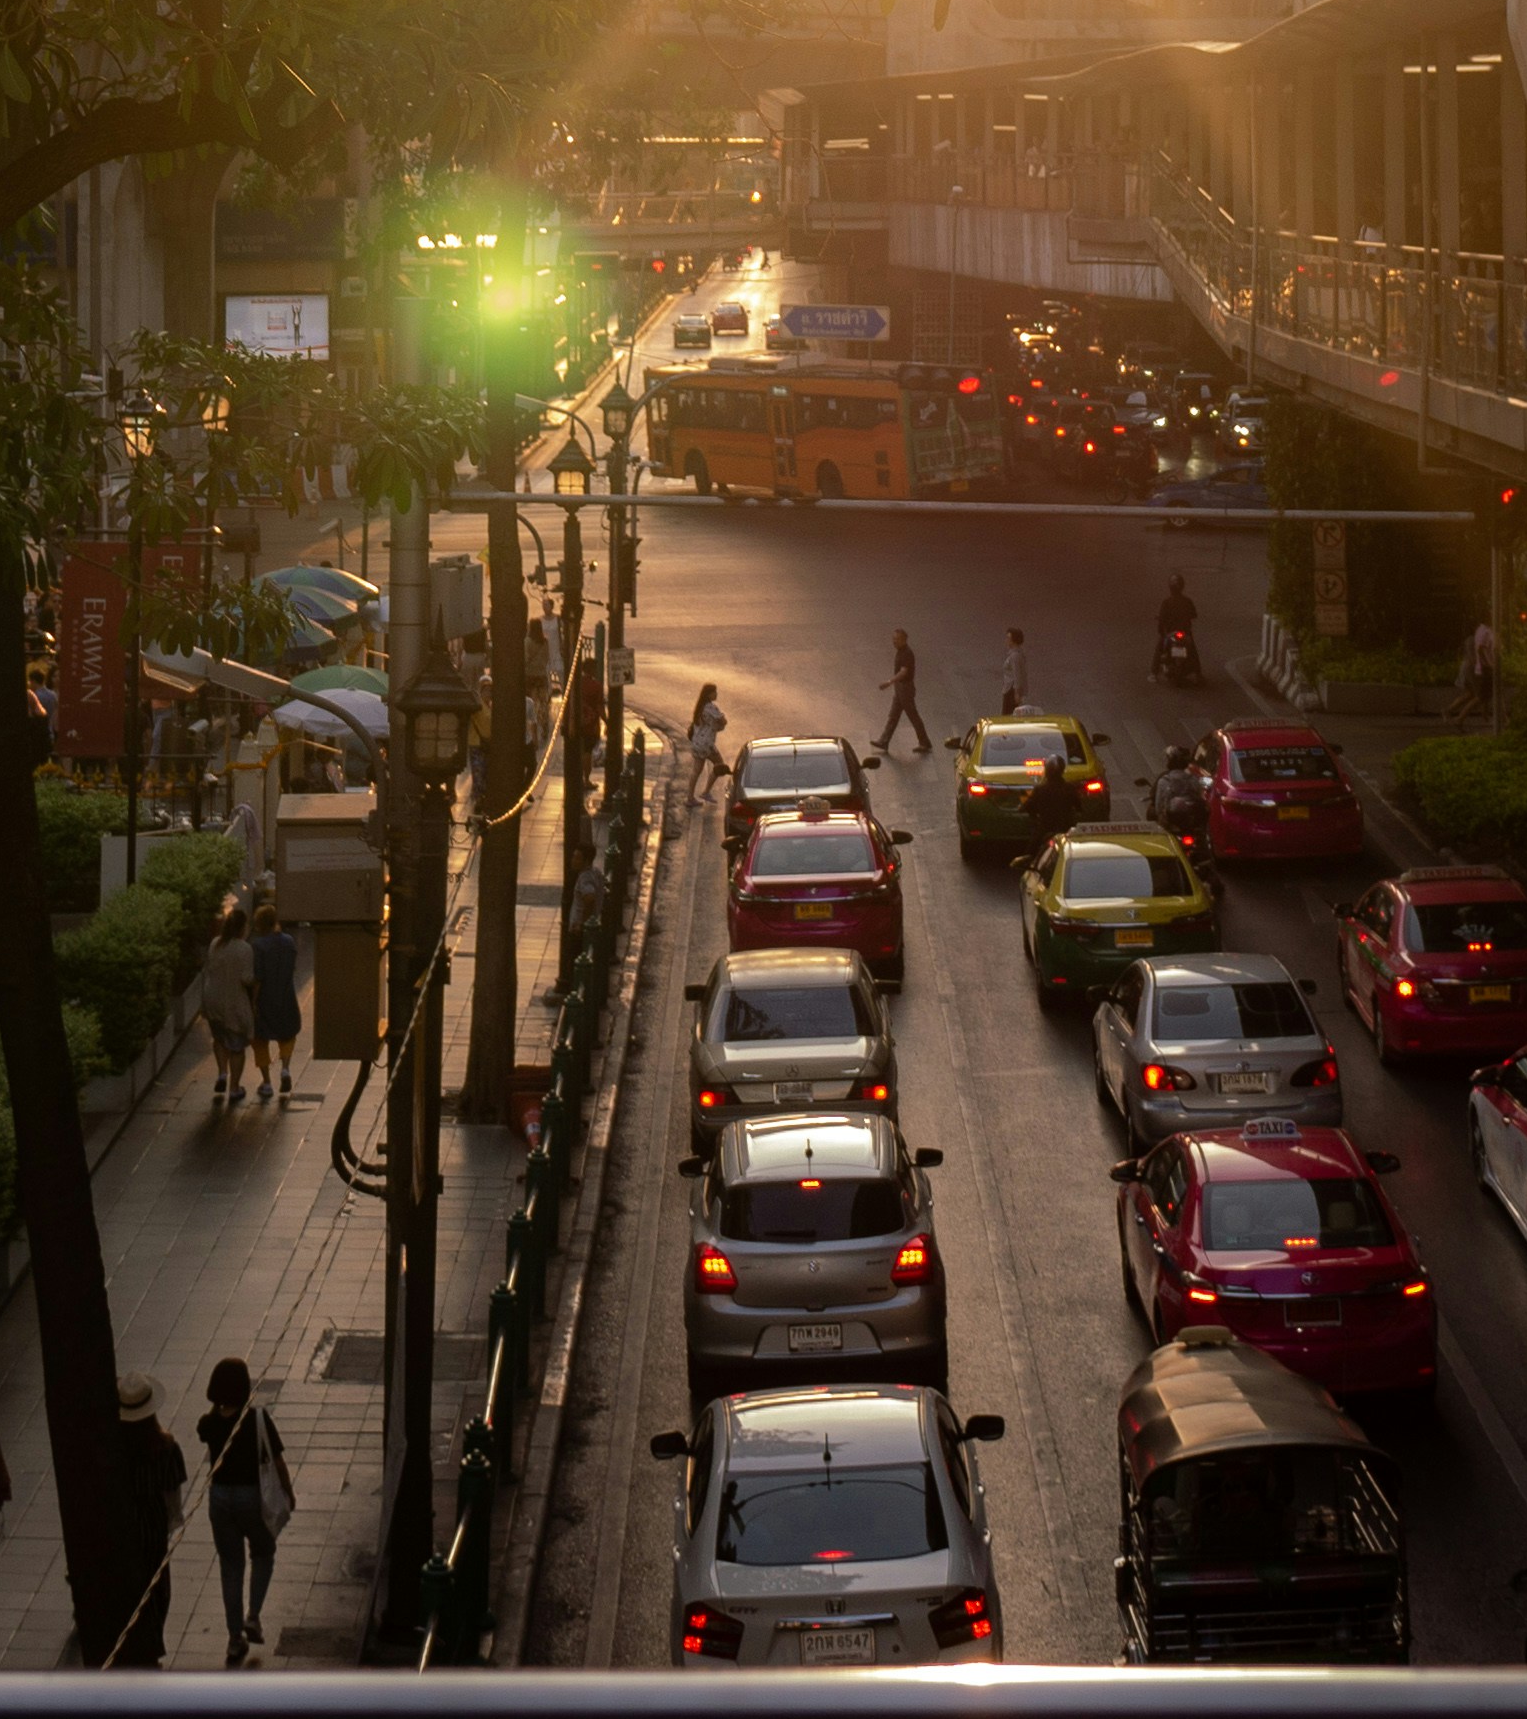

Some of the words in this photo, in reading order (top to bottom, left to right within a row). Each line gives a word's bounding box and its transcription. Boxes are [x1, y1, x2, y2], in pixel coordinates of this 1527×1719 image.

[80, 597, 106, 703] ERAWAN
[1259, 1121, 1283, 1134] TAXI
[815, 1326, 839, 1338] 2949
[837, 1633, 870, 1650] 6547
